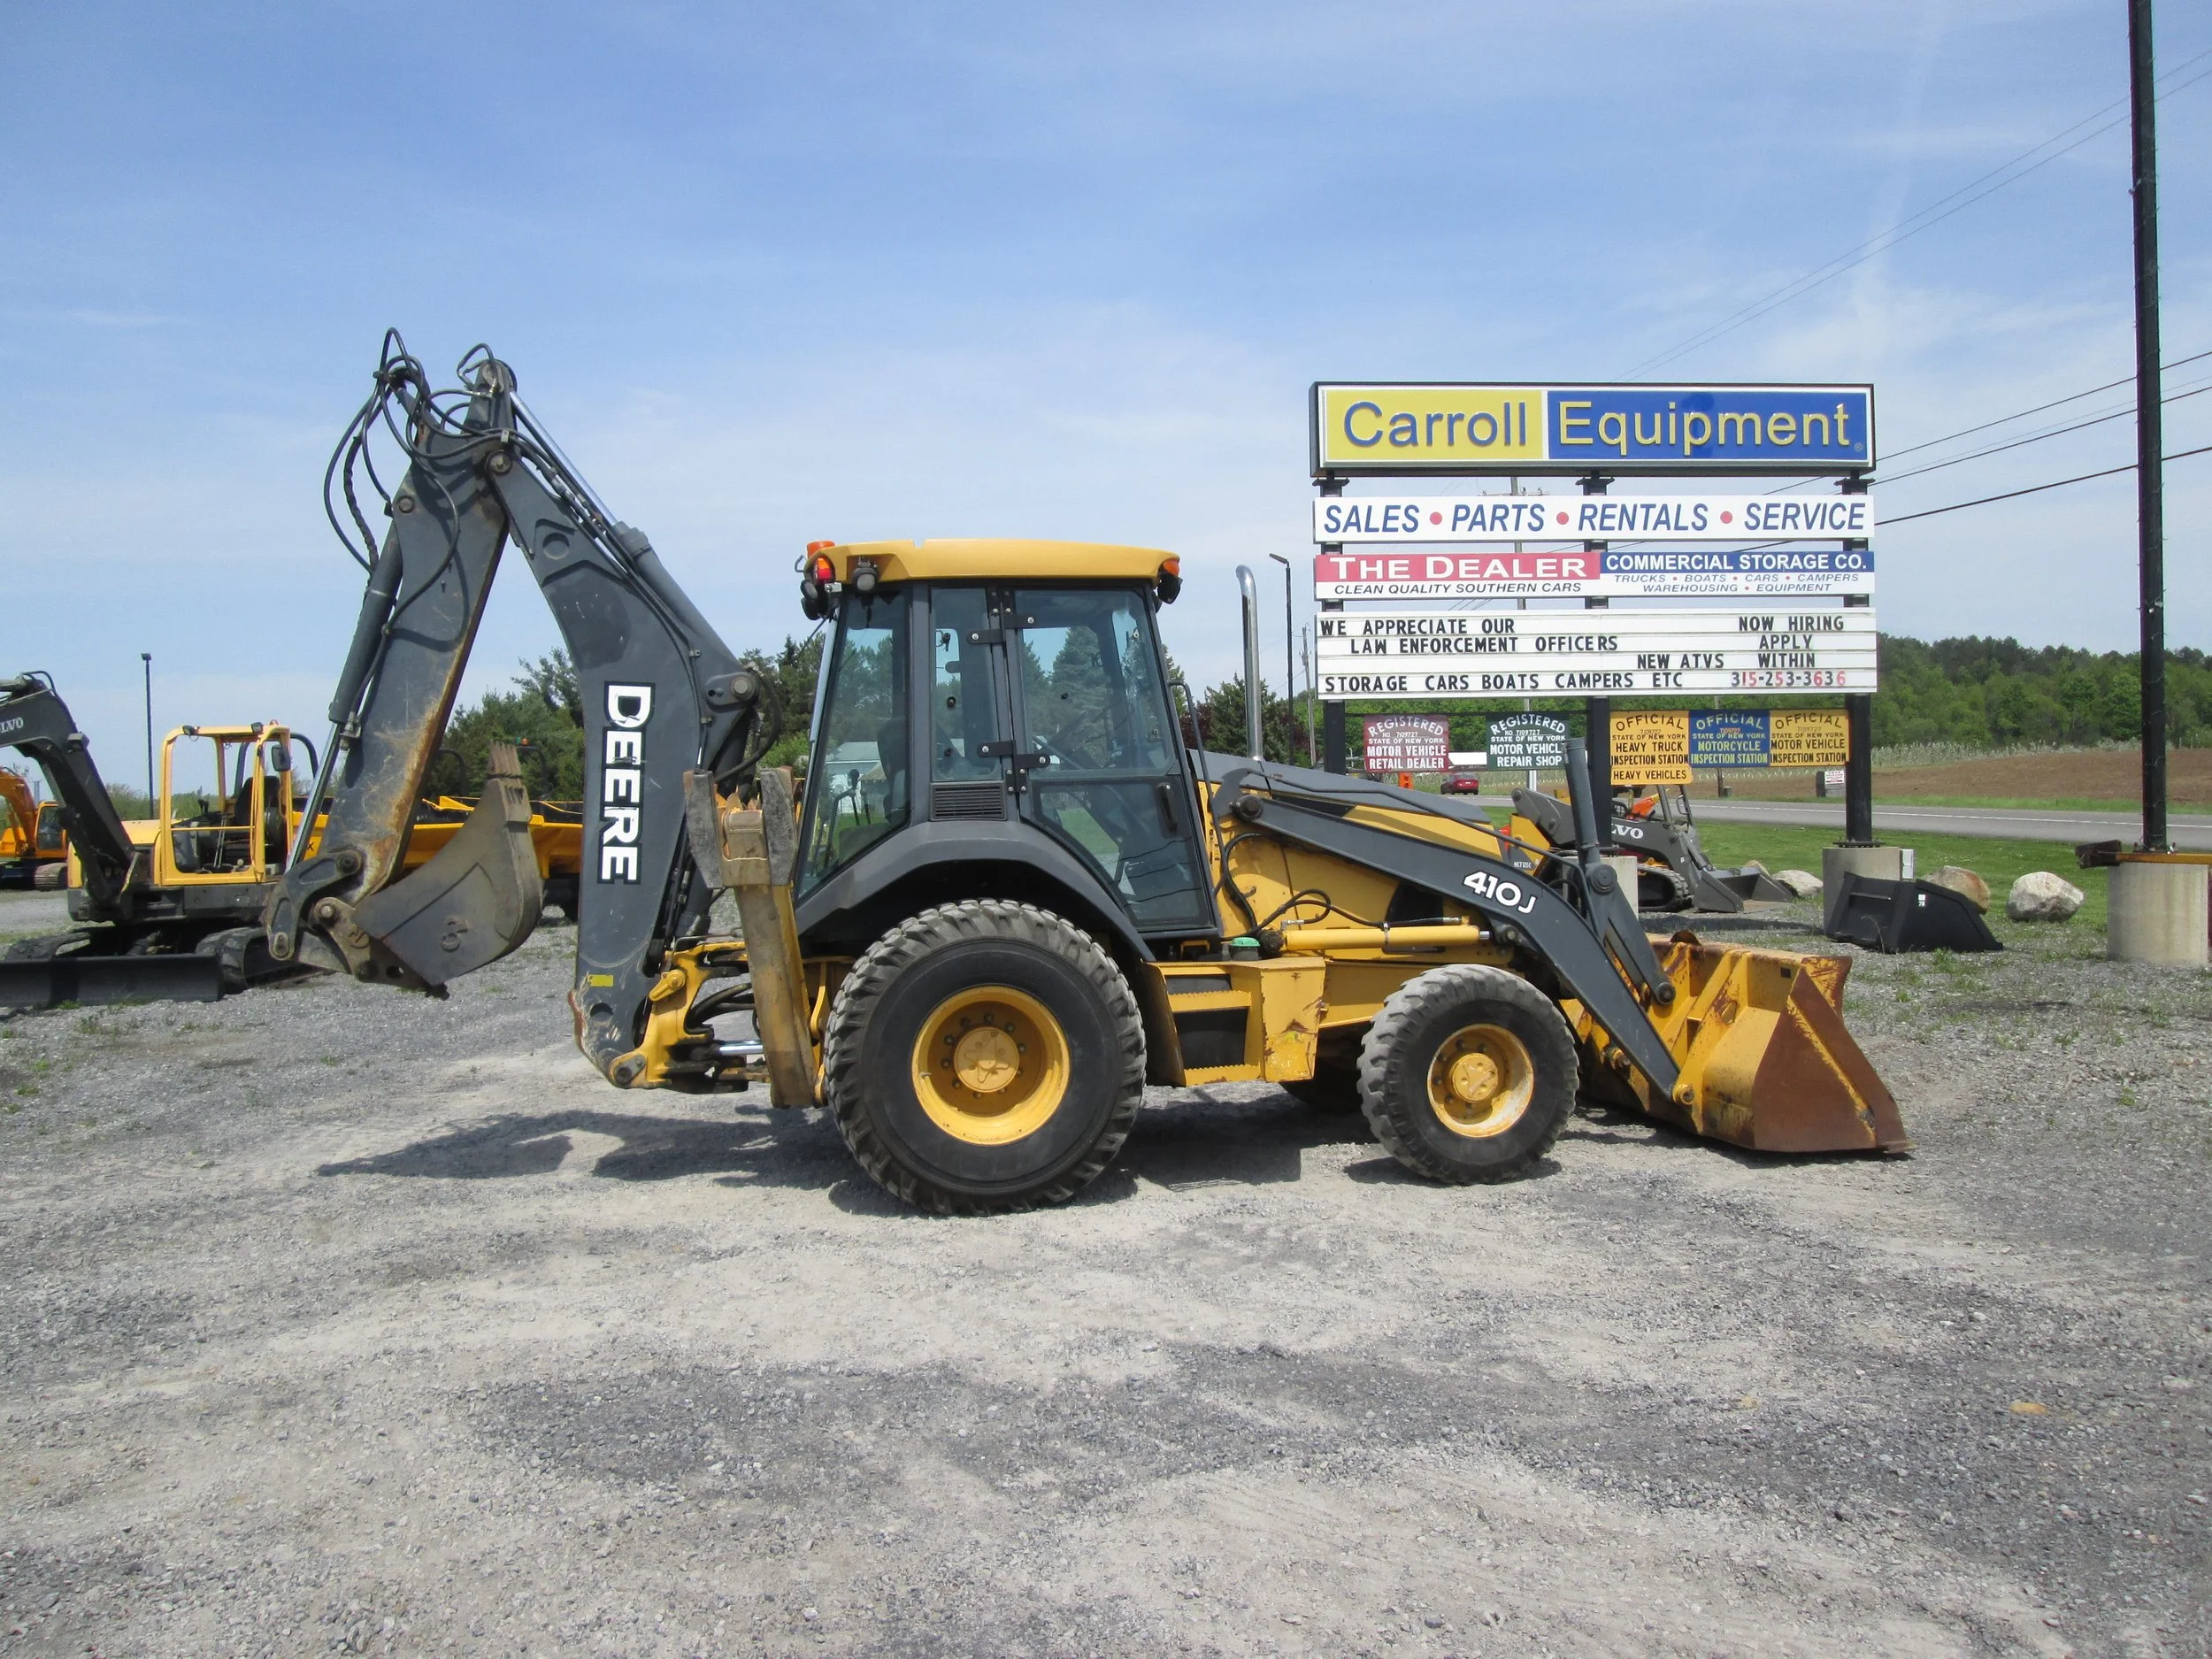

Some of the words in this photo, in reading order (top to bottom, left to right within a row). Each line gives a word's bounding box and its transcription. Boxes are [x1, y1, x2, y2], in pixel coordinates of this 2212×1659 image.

[1344, 401, 1526, 447] Carroll
[1559, 401, 1850, 456] Equipment
[1324, 504, 1419, 534] SALES
[1451, 503, 1545, 533] PARTS
[1578, 503, 1709, 532] RENTALS
[1744, 503, 1866, 531] SERVICE
[1329, 557, 1410, 580] THE
[1425, 556, 1587, 579] DEALER
[1606, 554, 1734, 571] COMMERCIAL
[1739, 554, 1829, 570] STORAGE
[1834, 554, 1867, 570] CO.
[1615, 574, 1666, 583] TRUCKS
[1797, 573, 1859, 582] CAMPERS
[1334, 584, 1384, 595] CLEAN
[1388, 583, 1451, 595] QUALITY
[1455, 582, 1537, 594] SOUTHERN
[1541, 582, 1582, 593] CARS
[1642, 584, 1739, 593] WAREHOUSING
[1755, 583, 1832, 593] EQUIPMENT
[1321, 619, 1347, 635] WE
[1363, 618, 1468, 635] APPRECIATE
[1481, 618, 1515, 634] OUR
[1739, 616, 1774, 632] NOW
[1788, 615, 1845, 632] HIRING
[1350, 638, 1387, 655] LAW
[1399, 636, 1518, 654] ENFORCEMENT
[1535, 635, 1618, 652] OFFICERS
[1759, 634, 1813, 650] APPLY
[1637, 654, 1671, 669] NEW
[1680, 653, 1724, 669] ATVS
[1758, 652, 1815, 668] WITHIN
[1325, 675, 1408, 692] STORAGE
[1425, 674, 1469, 691] CARS
[1481, 673, 1540, 690] BOATS
[1555, 672, 1633, 689] CAMPERS
[1652, 672, 1683, 687] ETC
[1731, 670, 1846, 687] 315-253-3636
[1368, 716, 1444, 737] REGISTERED
[1490, 713, 1565, 735] REGISTERED
[1616, 713, 1684, 731] OFFICIAL
[1696, 712, 1763, 730] OFFICIAL
[1775, 712, 1842, 730] OFFICIAL
[1367, 745, 1402, 757] MOTOR
[1405, 745, 1447, 757] VEHICLE
[1490, 744, 1523, 755] MOTOR
[1525, 743, 1563, 754] VEHICL
[1616, 742, 1646, 752] HEAVY
[1652, 741, 1683, 752] TRUCK
[1698, 741, 1761, 751] MOTORCYCLE
[1770, 739, 1802, 749] MOTOR
[1806, 738, 1845, 749] VEHICLE
[1370, 758, 1404, 770] RETAIL
[1407, 757, 1444, 769] DEALER
[1497, 756, 1532, 767] REPAIR
[1535, 756, 1563, 766] SHOP
[1610, 755, 1655, 766] INSPECTION
[1658, 754, 1688, 764] STATION
[1691, 753, 1735, 764] INSPECTION
[1737, 753, 1768, 764] STATION
[1770, 752, 1814, 764] INSPECTION
[1816, 752, 1847, 763] STATION
[600, 685, 652, 881] DEERE
[1613, 770, 1641, 780] HEAVY
[1646, 770, 1687, 780] VEHICLES
[1463, 871, 1537, 914] 410J
